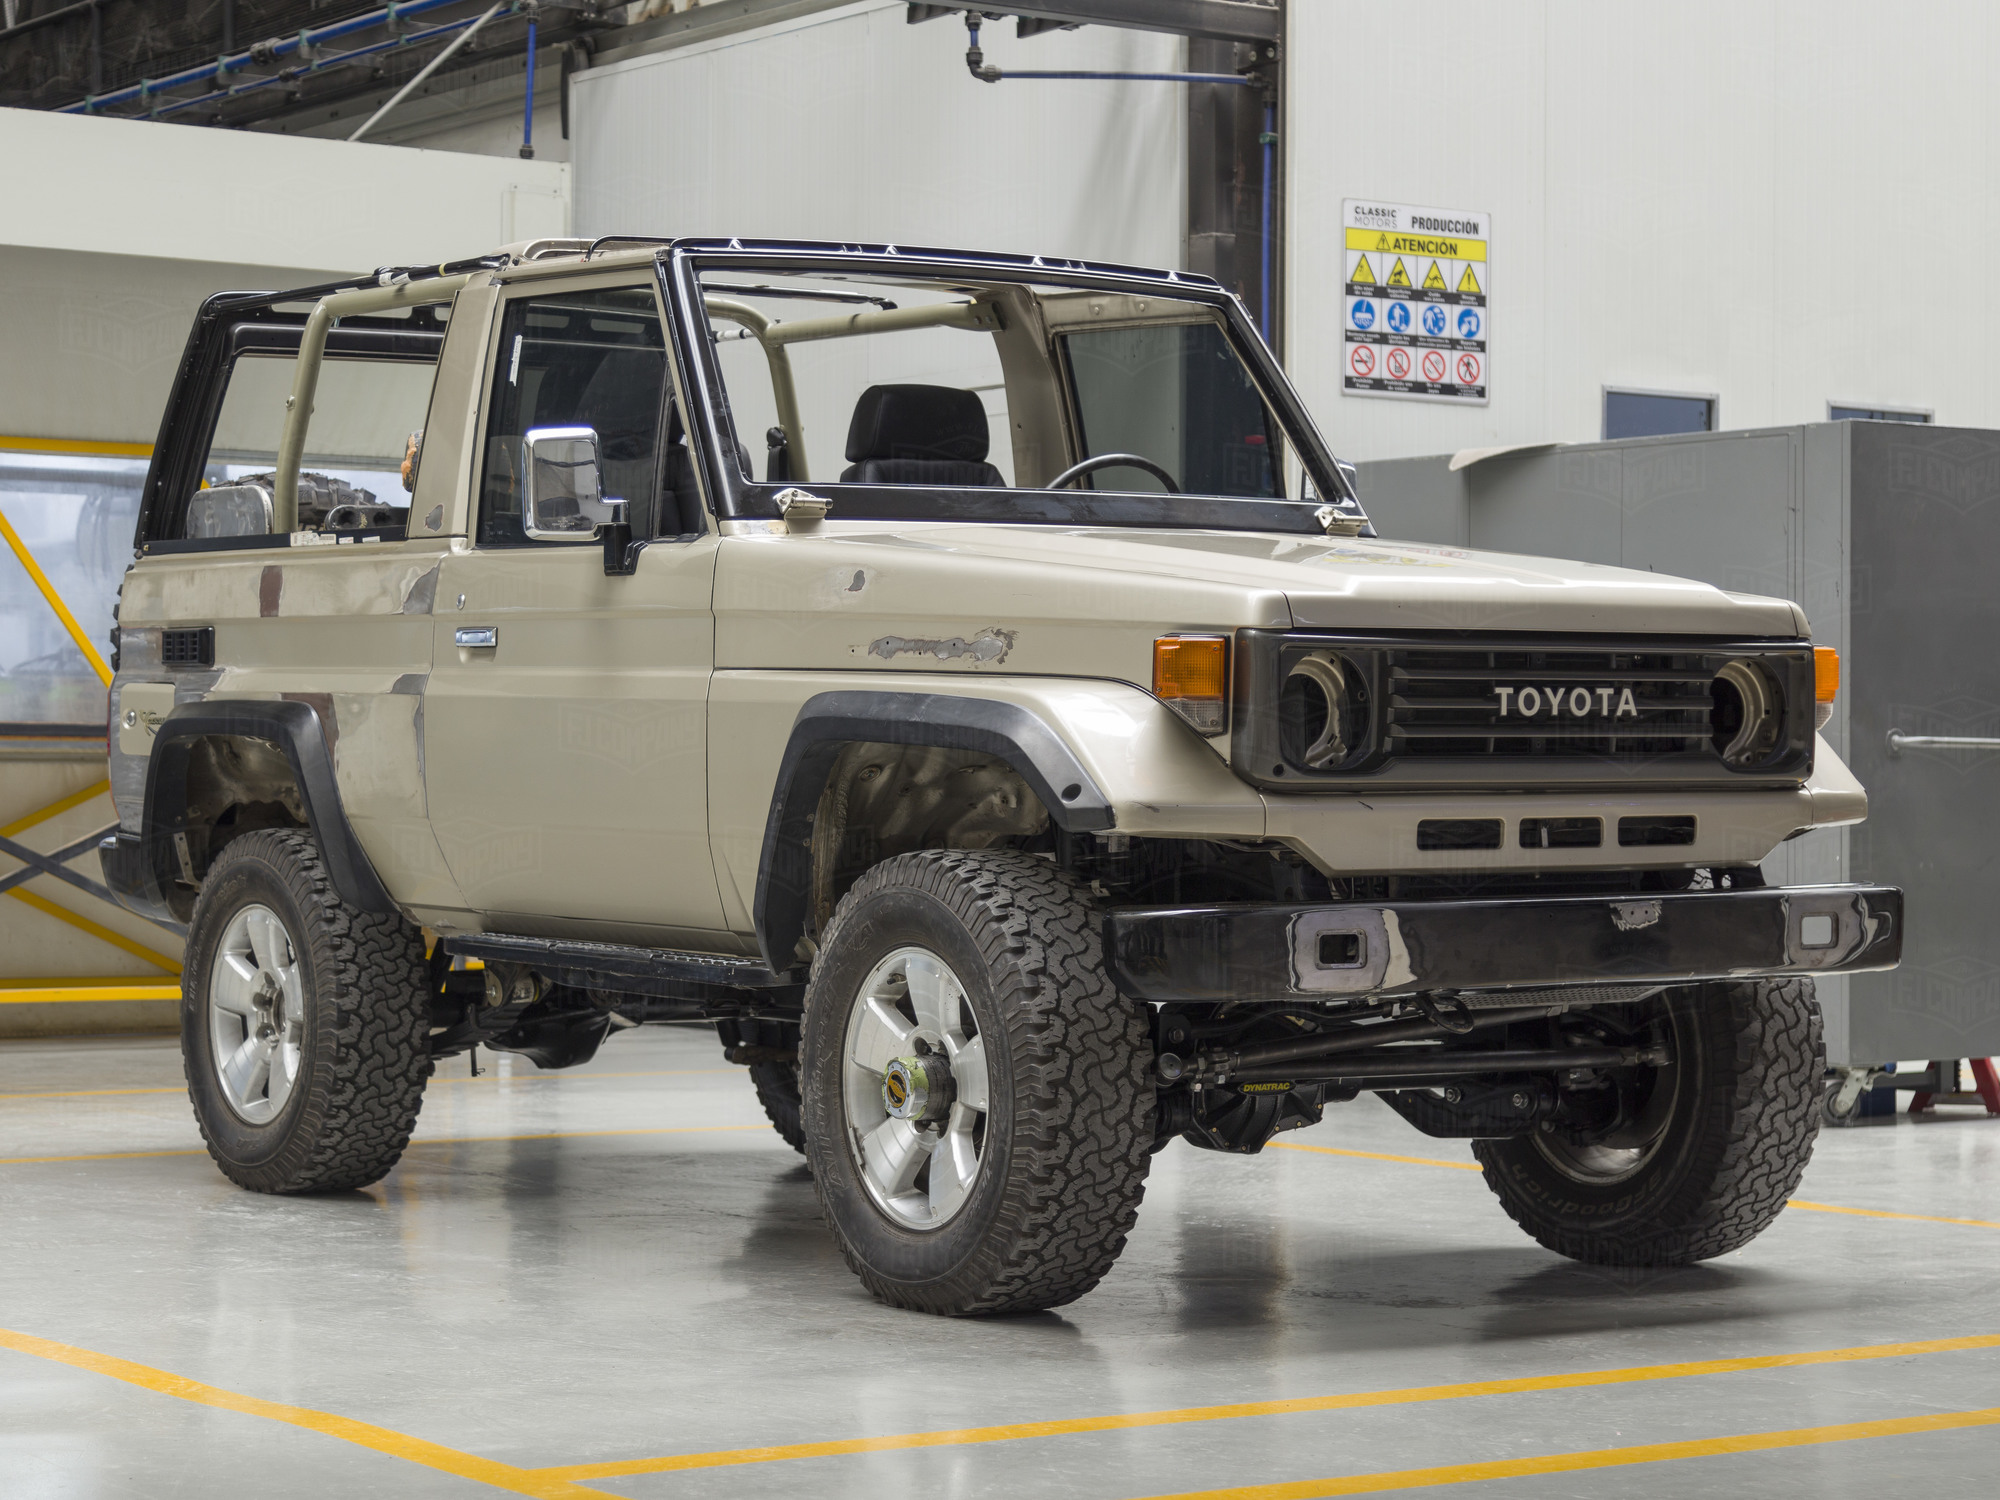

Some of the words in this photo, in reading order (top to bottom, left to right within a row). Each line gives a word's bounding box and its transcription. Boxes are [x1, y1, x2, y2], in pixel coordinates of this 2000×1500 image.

[1354, 205, 1397, 218] CLASSIC
[1354, 215, 1398, 229] MOTORS
[1411, 215, 1480, 235] PRODUCCIÓN
[1393, 237, 1458, 256] ATENCIÓN
[1494, 687, 1638, 717] TOYOTA
[1243, 1082, 1291, 1092] DYNATRAC
[1512, 1164, 1663, 1215] BFGoodrich
